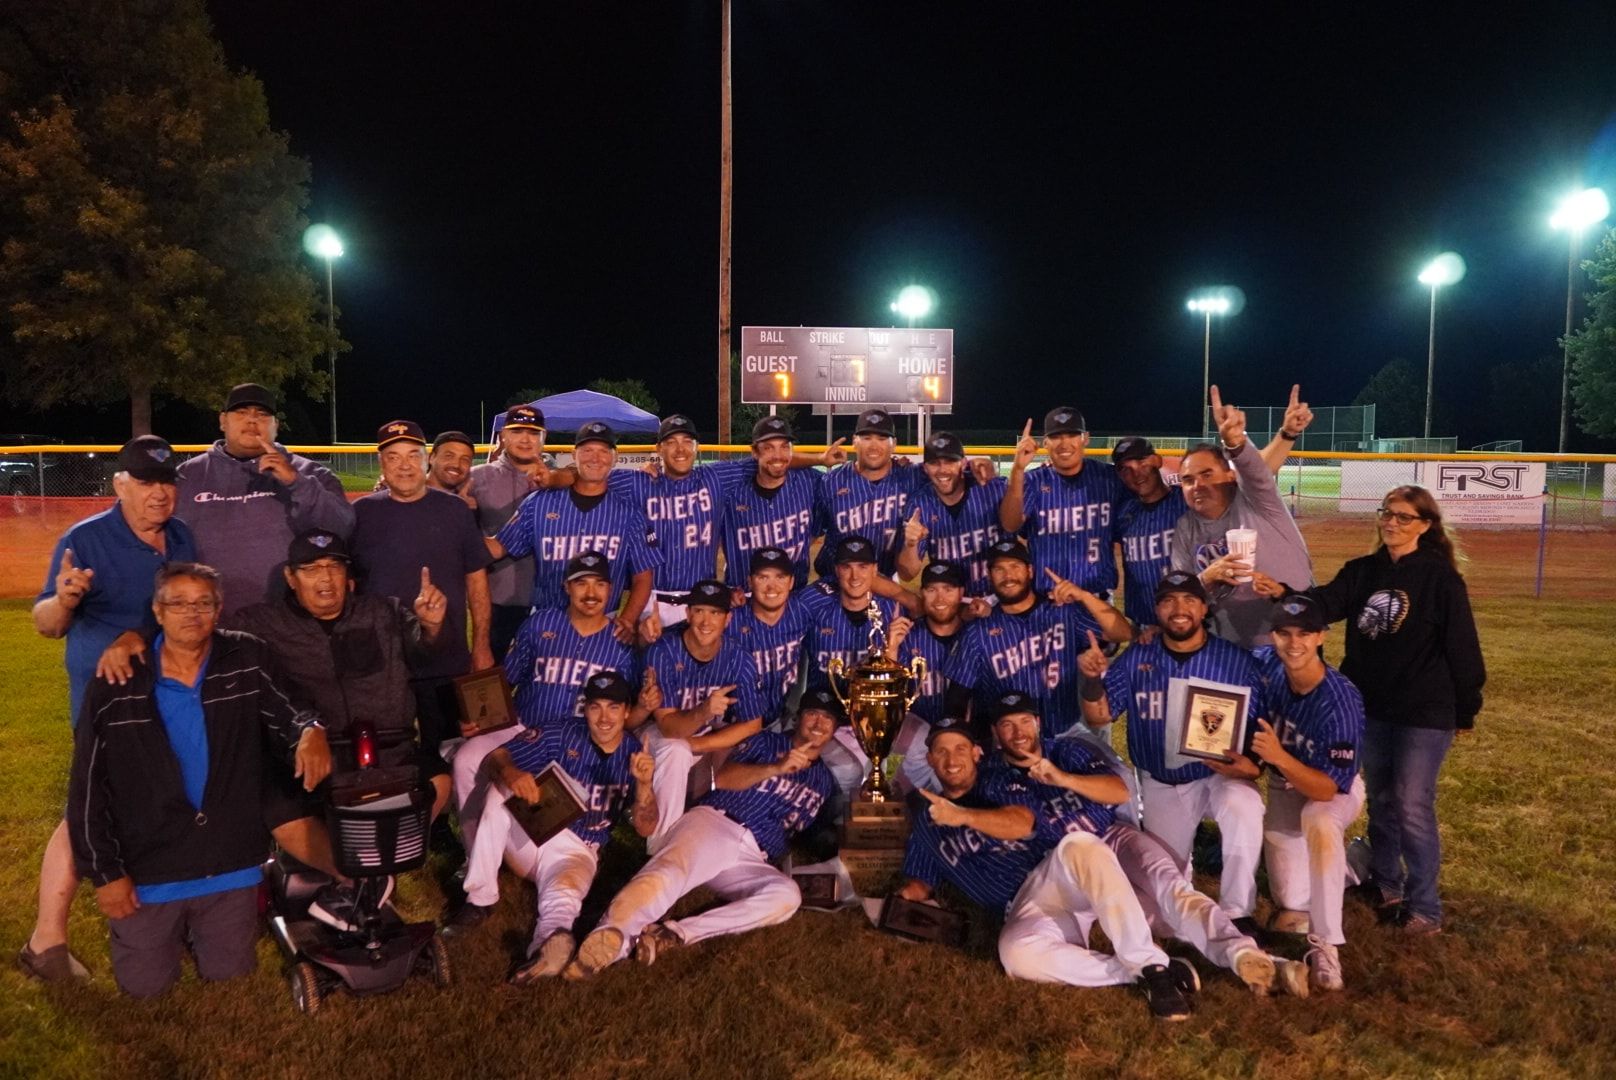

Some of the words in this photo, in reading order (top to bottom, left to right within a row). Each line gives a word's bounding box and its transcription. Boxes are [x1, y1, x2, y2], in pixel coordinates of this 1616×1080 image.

[760, 331, 784, 343] BALL
[809, 332, 845, 344] STRIKE
[746, 356, 798, 373] GUEST
[850, 359, 865, 383] 7
[898, 357, 947, 375] HOME
[775, 373, 789, 398] 7
[825, 386, 866, 402] INNING
[924, 376, 939, 400] 4
[1437, 463, 1530, 492] FIRST
[647, 487, 712, 521] CHIEFS
[685, 521, 712, 549] 24
[737, 509, 809, 551] CHIEFS
[930, 525, 1000, 560] HIEFS
[1087, 538, 1100, 564] 5
[1122, 529, 1175, 562] HIEF
[991, 622, 1066, 680] CHIEFS
[534, 656, 616, 688] CHIEF
[1329, 749, 1354, 760] PJM
